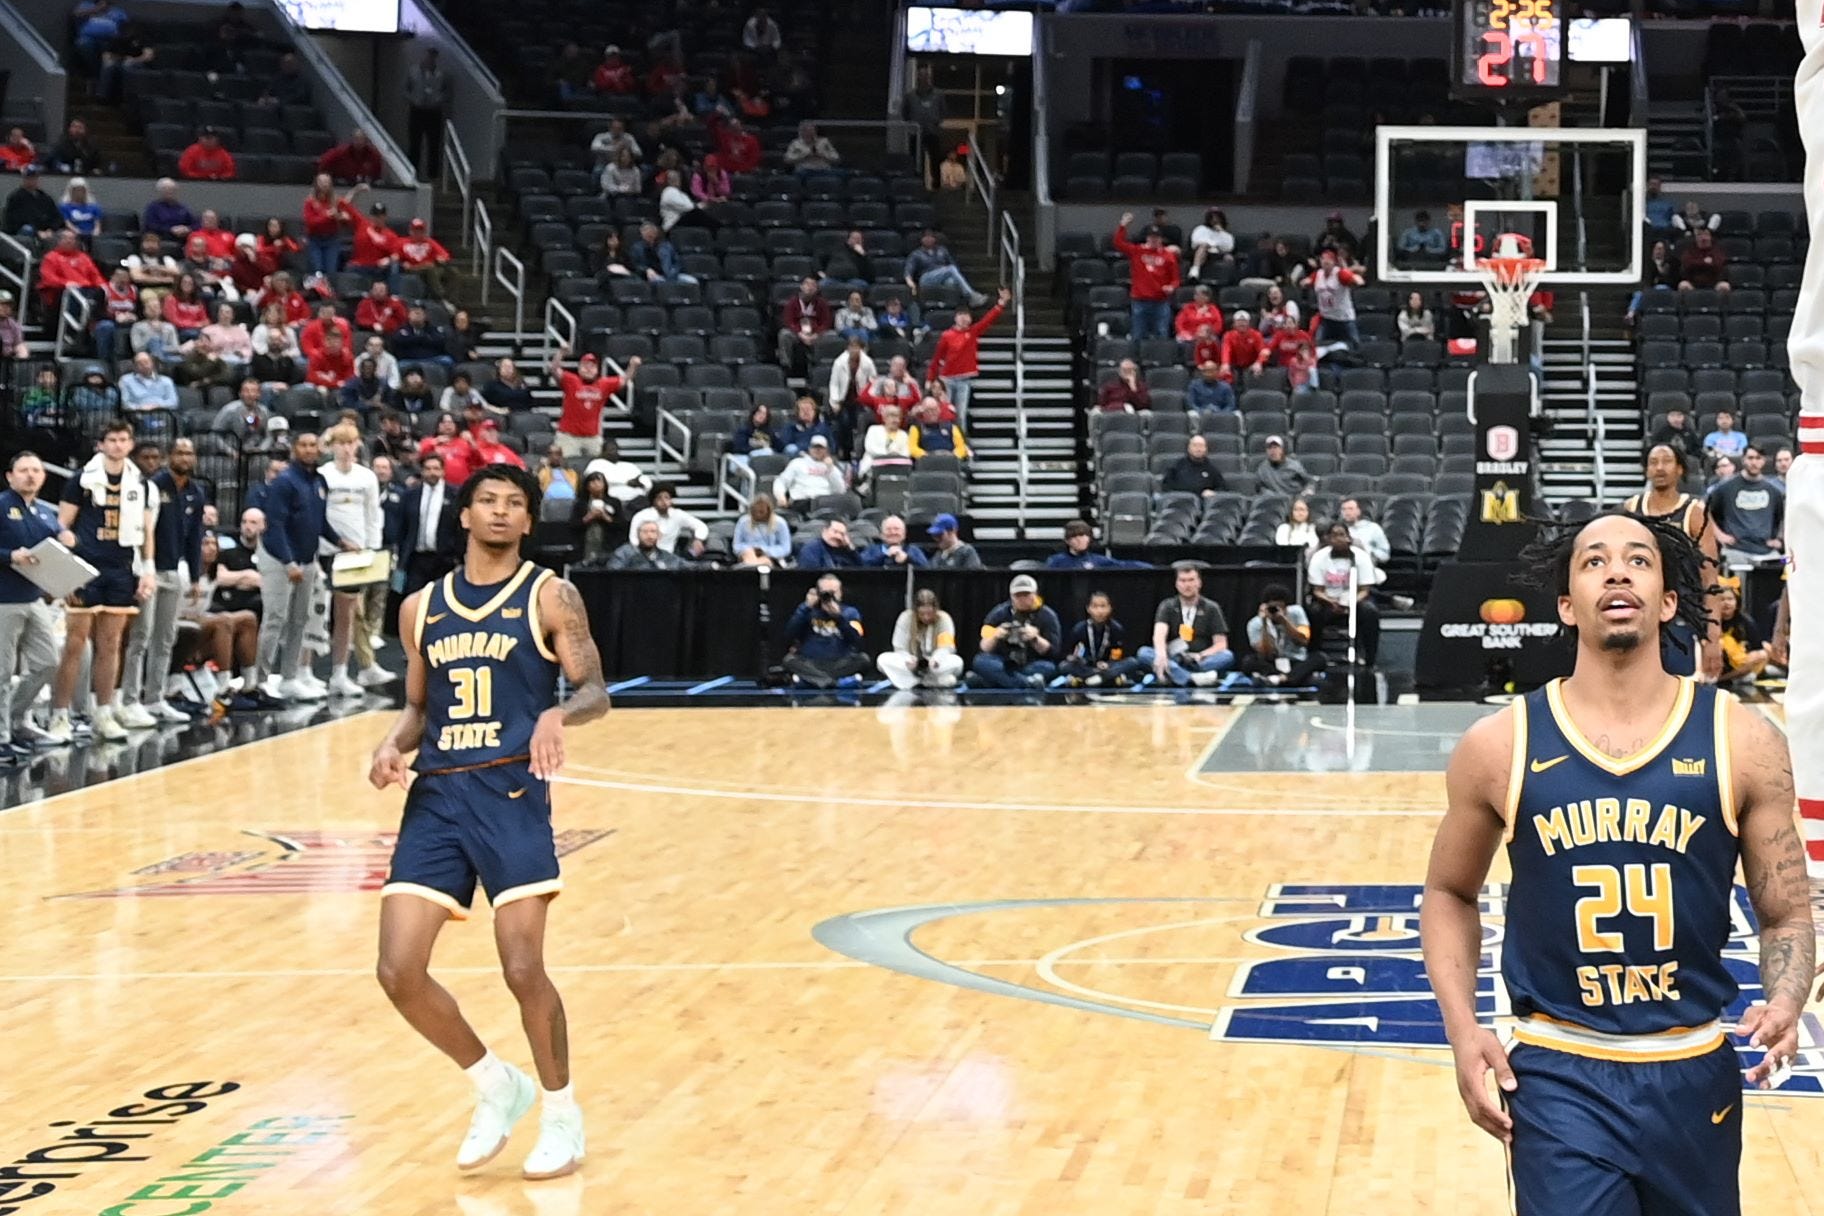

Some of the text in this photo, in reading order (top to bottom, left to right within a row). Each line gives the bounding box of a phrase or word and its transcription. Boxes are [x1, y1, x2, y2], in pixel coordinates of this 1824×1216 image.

[1477, 30, 1546, 87] 27
[427, 632, 518, 668] MURRAY
[1440, 623, 1487, 638] GREAT
[1481, 635, 1524, 649] BANK
[448, 666, 494, 720] 31
[437, 721, 502, 751] STATE
[1532, 797, 1706, 857] MURRAY
[1571, 863, 1675, 954] 24
[1577, 960, 1681, 1008] STATE
[0, 1080, 241, 1216] erprise
